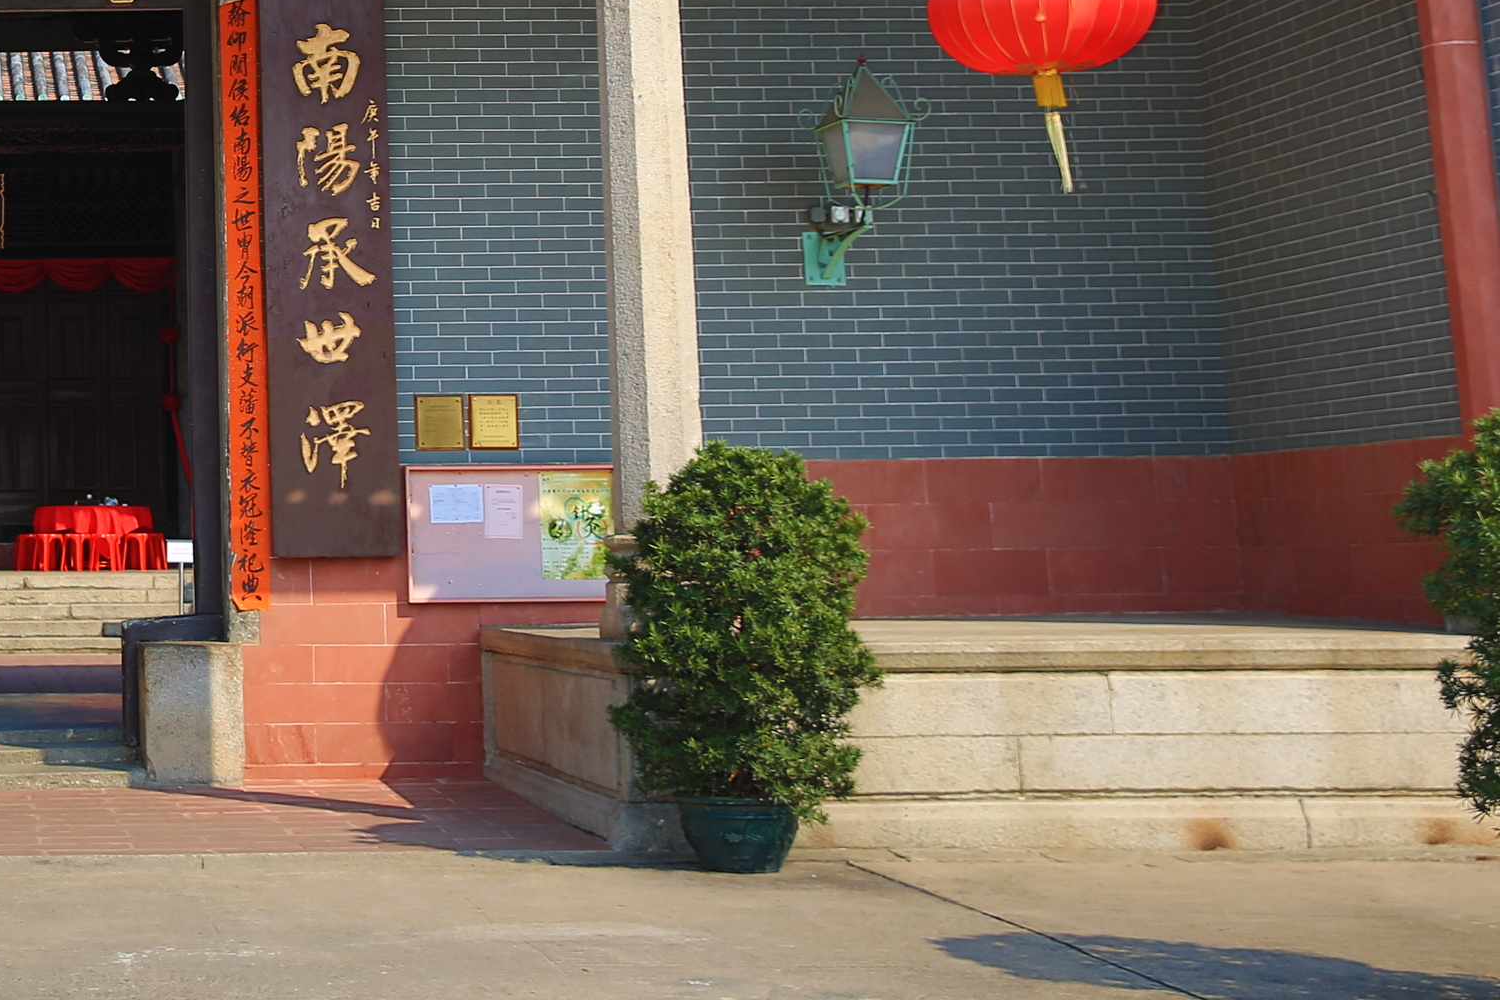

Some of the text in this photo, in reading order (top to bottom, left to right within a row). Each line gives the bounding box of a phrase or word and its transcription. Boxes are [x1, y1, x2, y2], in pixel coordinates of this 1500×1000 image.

[292, 22, 377, 489] 南陽承世澤
